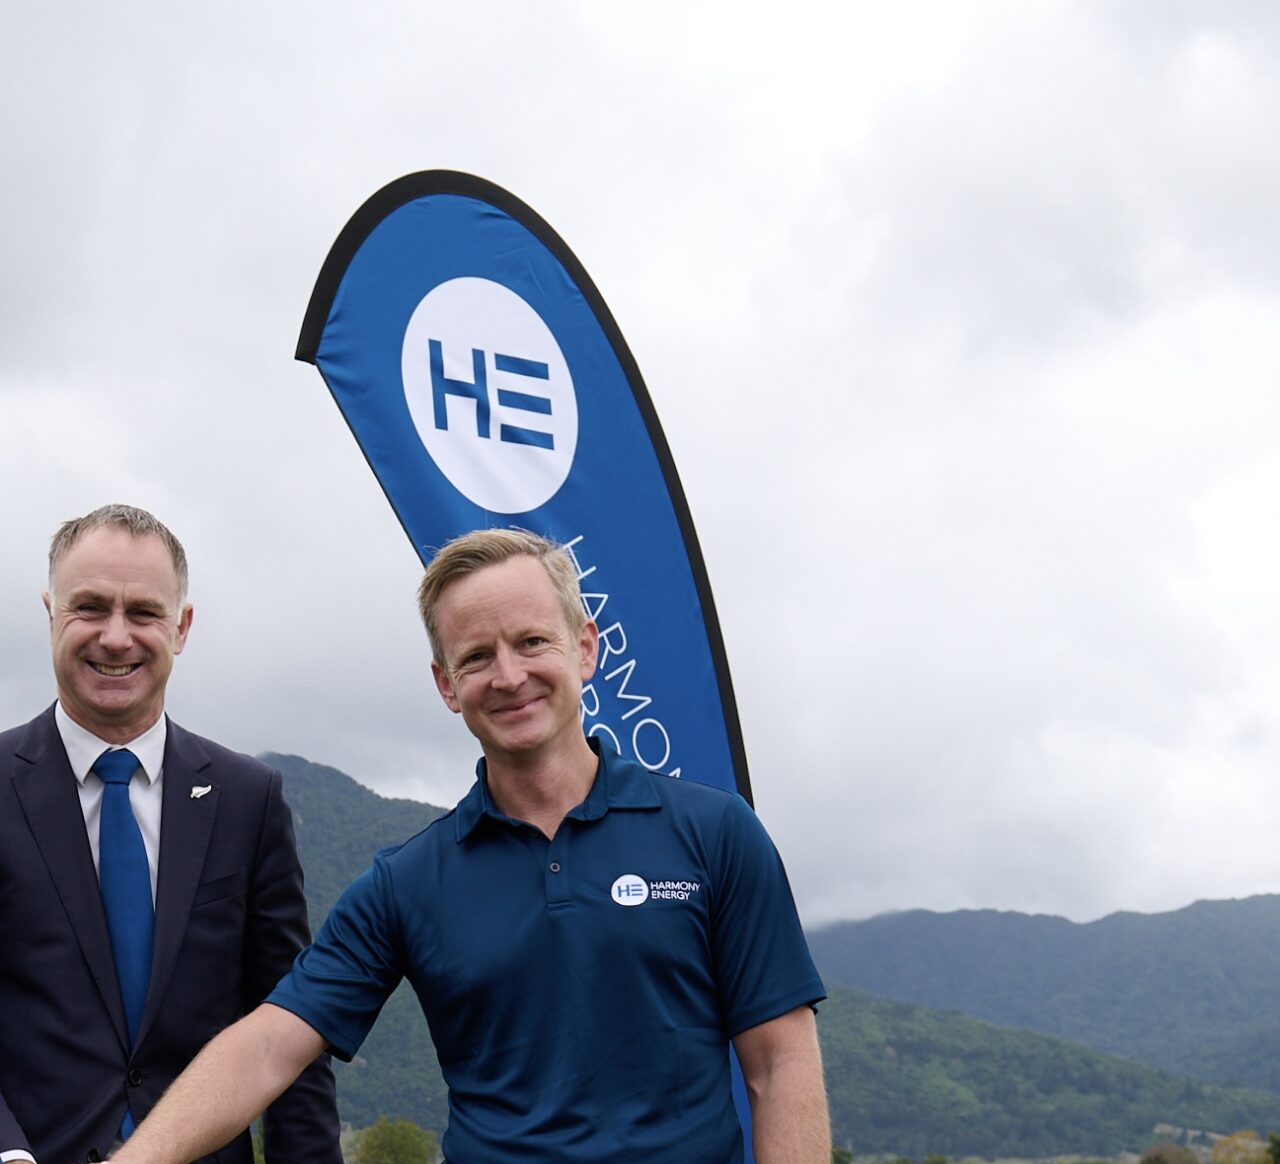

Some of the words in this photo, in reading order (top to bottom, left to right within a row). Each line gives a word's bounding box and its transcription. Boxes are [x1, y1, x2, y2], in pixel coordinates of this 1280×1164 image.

[427, 337, 556, 451] HE
[563, 535, 681, 779] HARMO
[650, 881, 701, 892] HARMONY
[651, 891, 690, 900] ENERGY
